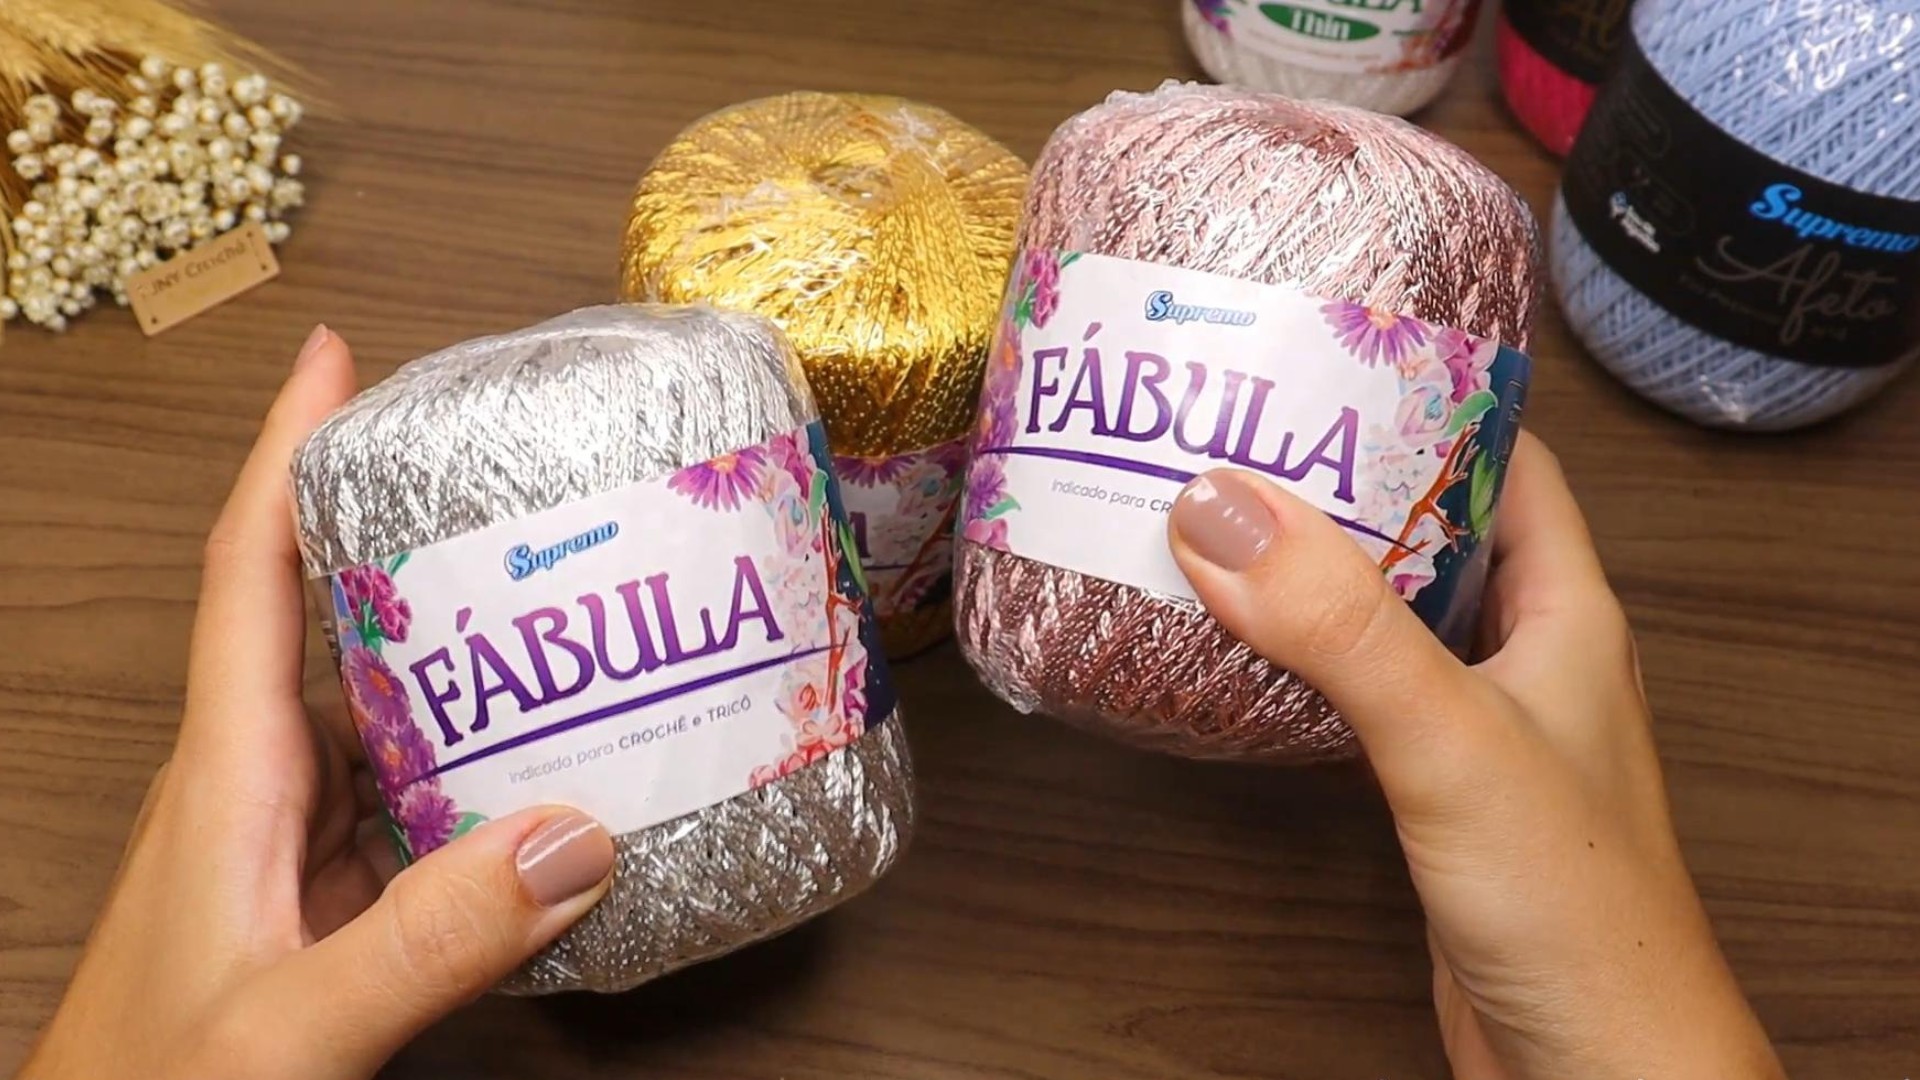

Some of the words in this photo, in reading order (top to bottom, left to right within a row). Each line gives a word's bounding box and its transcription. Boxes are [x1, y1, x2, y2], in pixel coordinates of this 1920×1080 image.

[1288, 8, 1352, 41] Thin
[1748, 182, 1920, 253] Supremo
[1144, 290, 1257, 327] Supremo
[1694, 235, 1897, 345] Afeto
[1025, 322, 1361, 504] FÁBULA
[1110, 491, 1145, 510] para
[504, 520, 619, 582] Supremo
[409, 554, 785, 748] FÁBULA
[576, 742, 615, 769] para
[617, 715, 690, 752] CROCHÊ
[692, 716, 703, 728] e
[705, 694, 753, 724] TRICÔ
